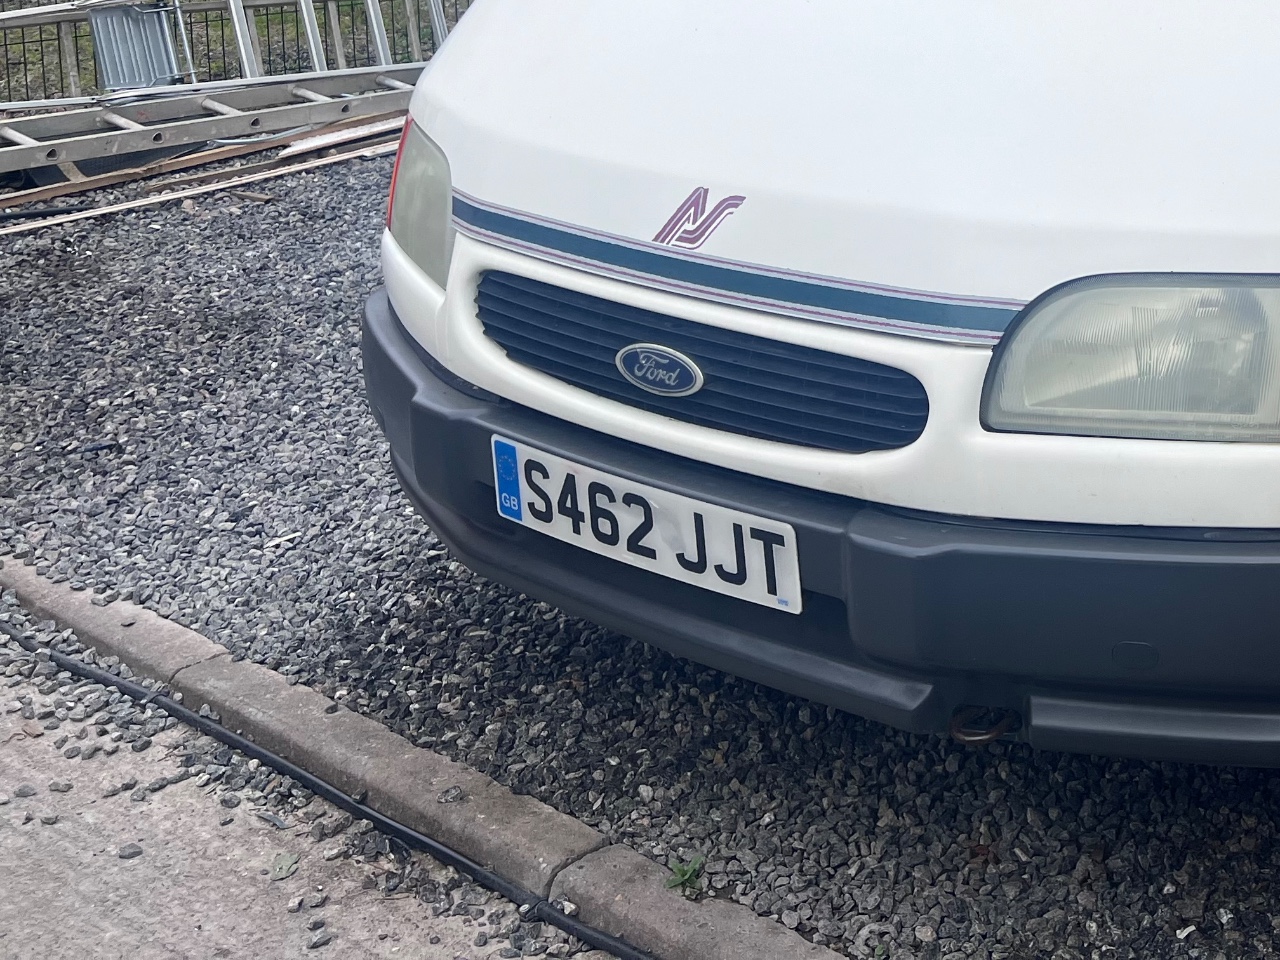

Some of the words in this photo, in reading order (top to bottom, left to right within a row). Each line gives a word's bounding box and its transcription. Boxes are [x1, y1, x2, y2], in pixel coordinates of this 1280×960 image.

[634, 352, 681, 386] Ford
[501, 493, 519, 511] GB
[524, 458, 657, 560] S462
[675, 513, 785, 597] JJT
